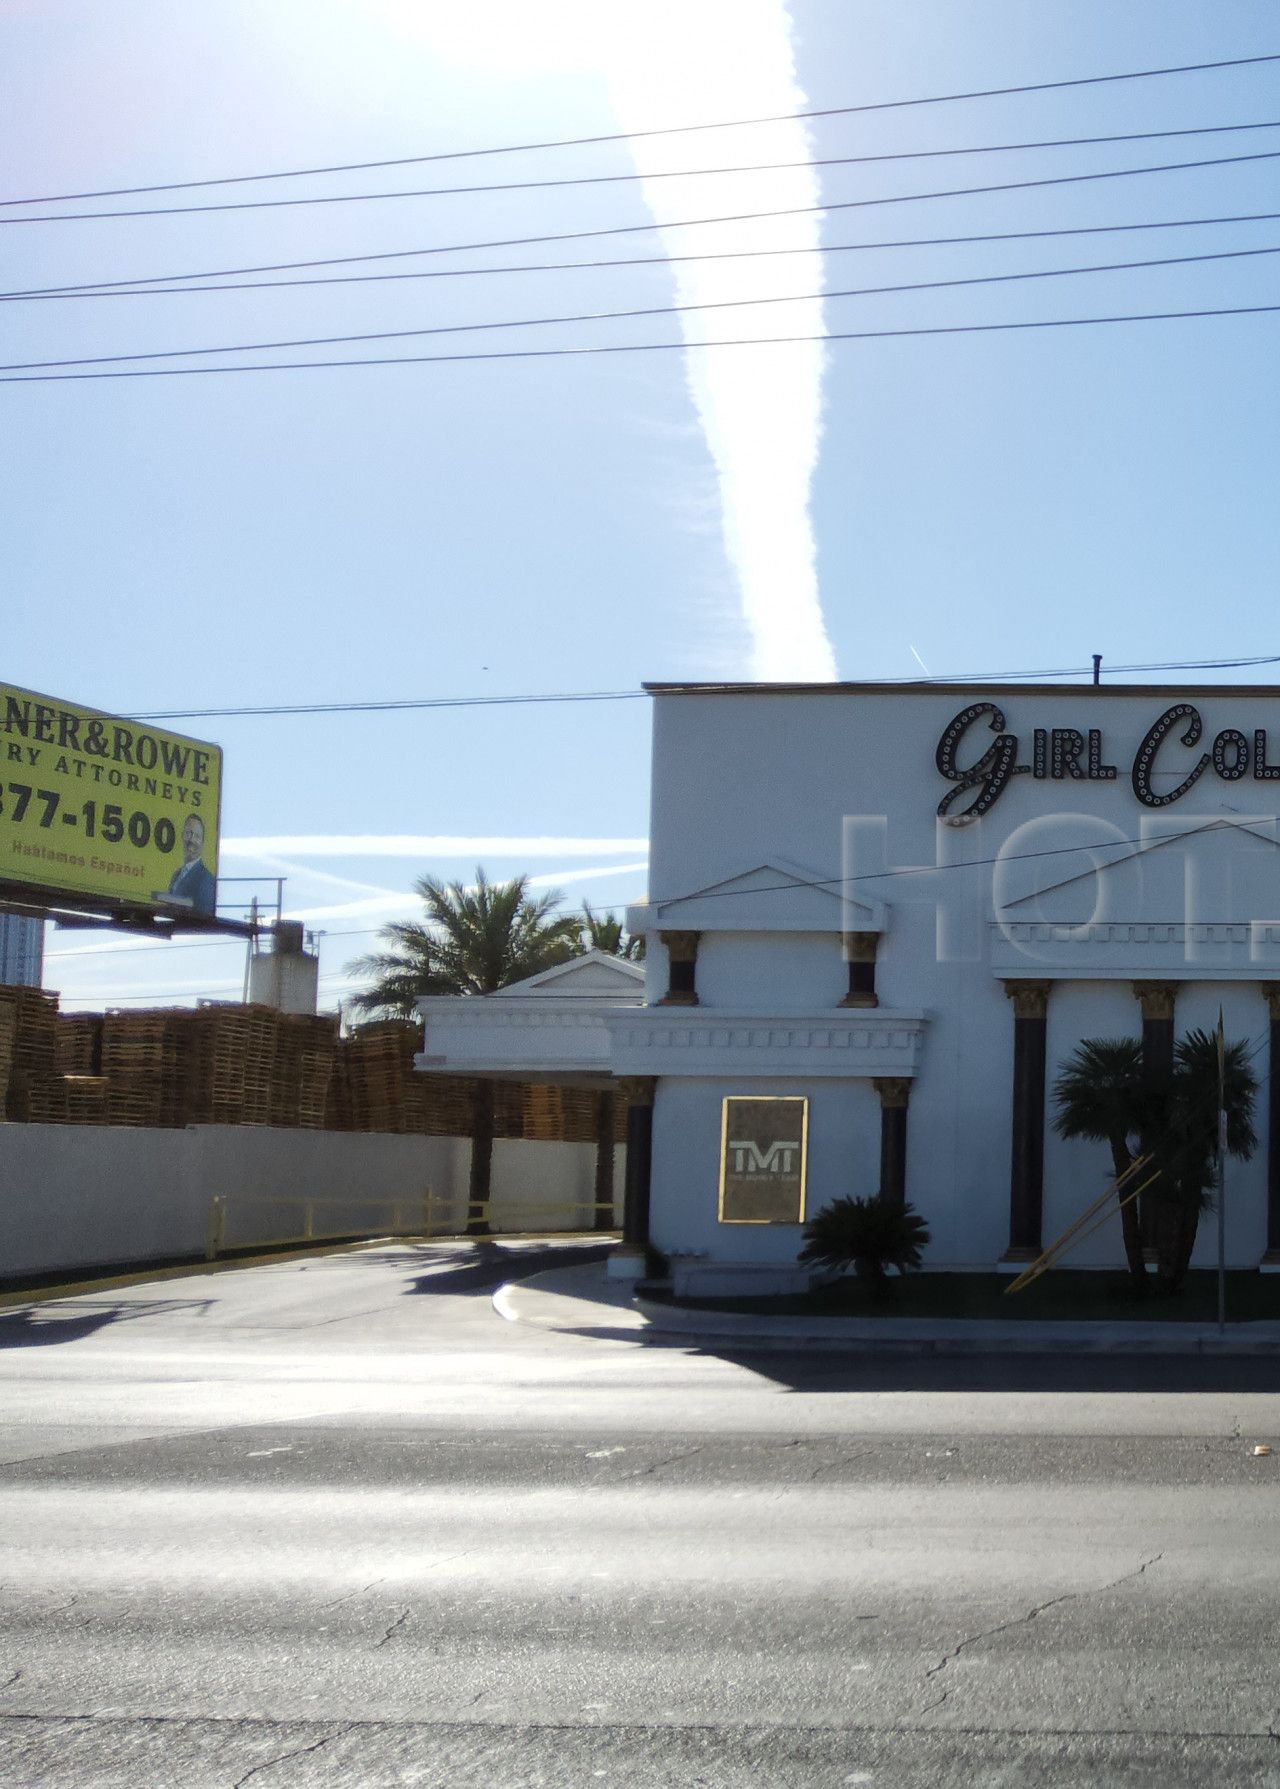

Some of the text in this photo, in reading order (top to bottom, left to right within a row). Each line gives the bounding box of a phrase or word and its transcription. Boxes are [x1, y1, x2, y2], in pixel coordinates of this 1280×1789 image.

[7, 742, 202, 807] RY ATTORNEYS
[0, 782, 176, 853] 77-1500
[728, 1141, 799, 1172] TMT
